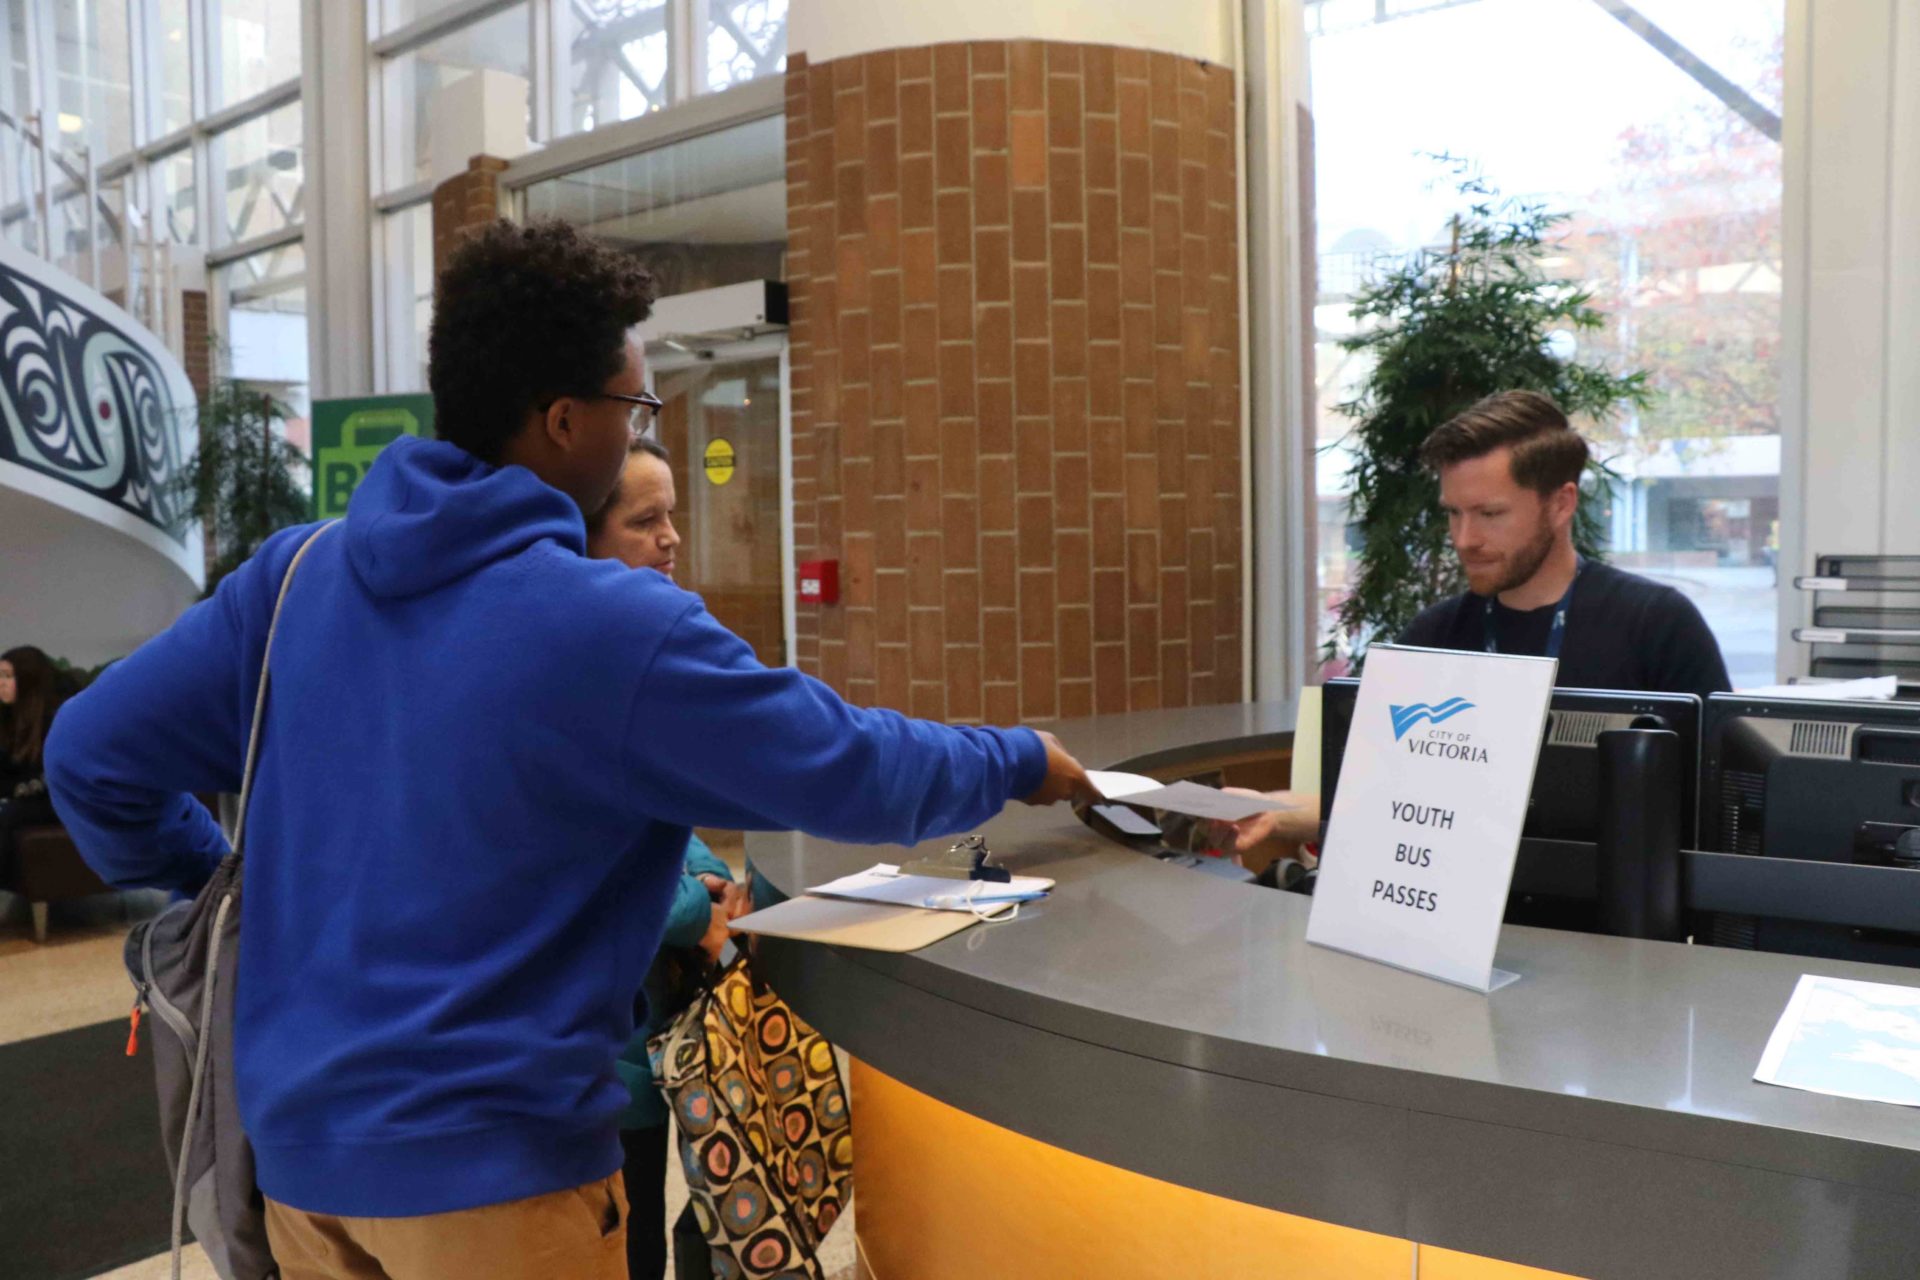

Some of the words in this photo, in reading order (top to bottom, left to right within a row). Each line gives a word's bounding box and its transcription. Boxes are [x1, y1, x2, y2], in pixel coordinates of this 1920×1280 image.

[1428, 729, 1454, 741] CITY
[1456, 732, 1471, 743] OF
[1408, 738, 1488, 763] VICTORIA
[1391, 800, 1455, 830] YOUTH
[1395, 842, 1432, 868] BUS
[1371, 879, 1438, 912] PASSES
